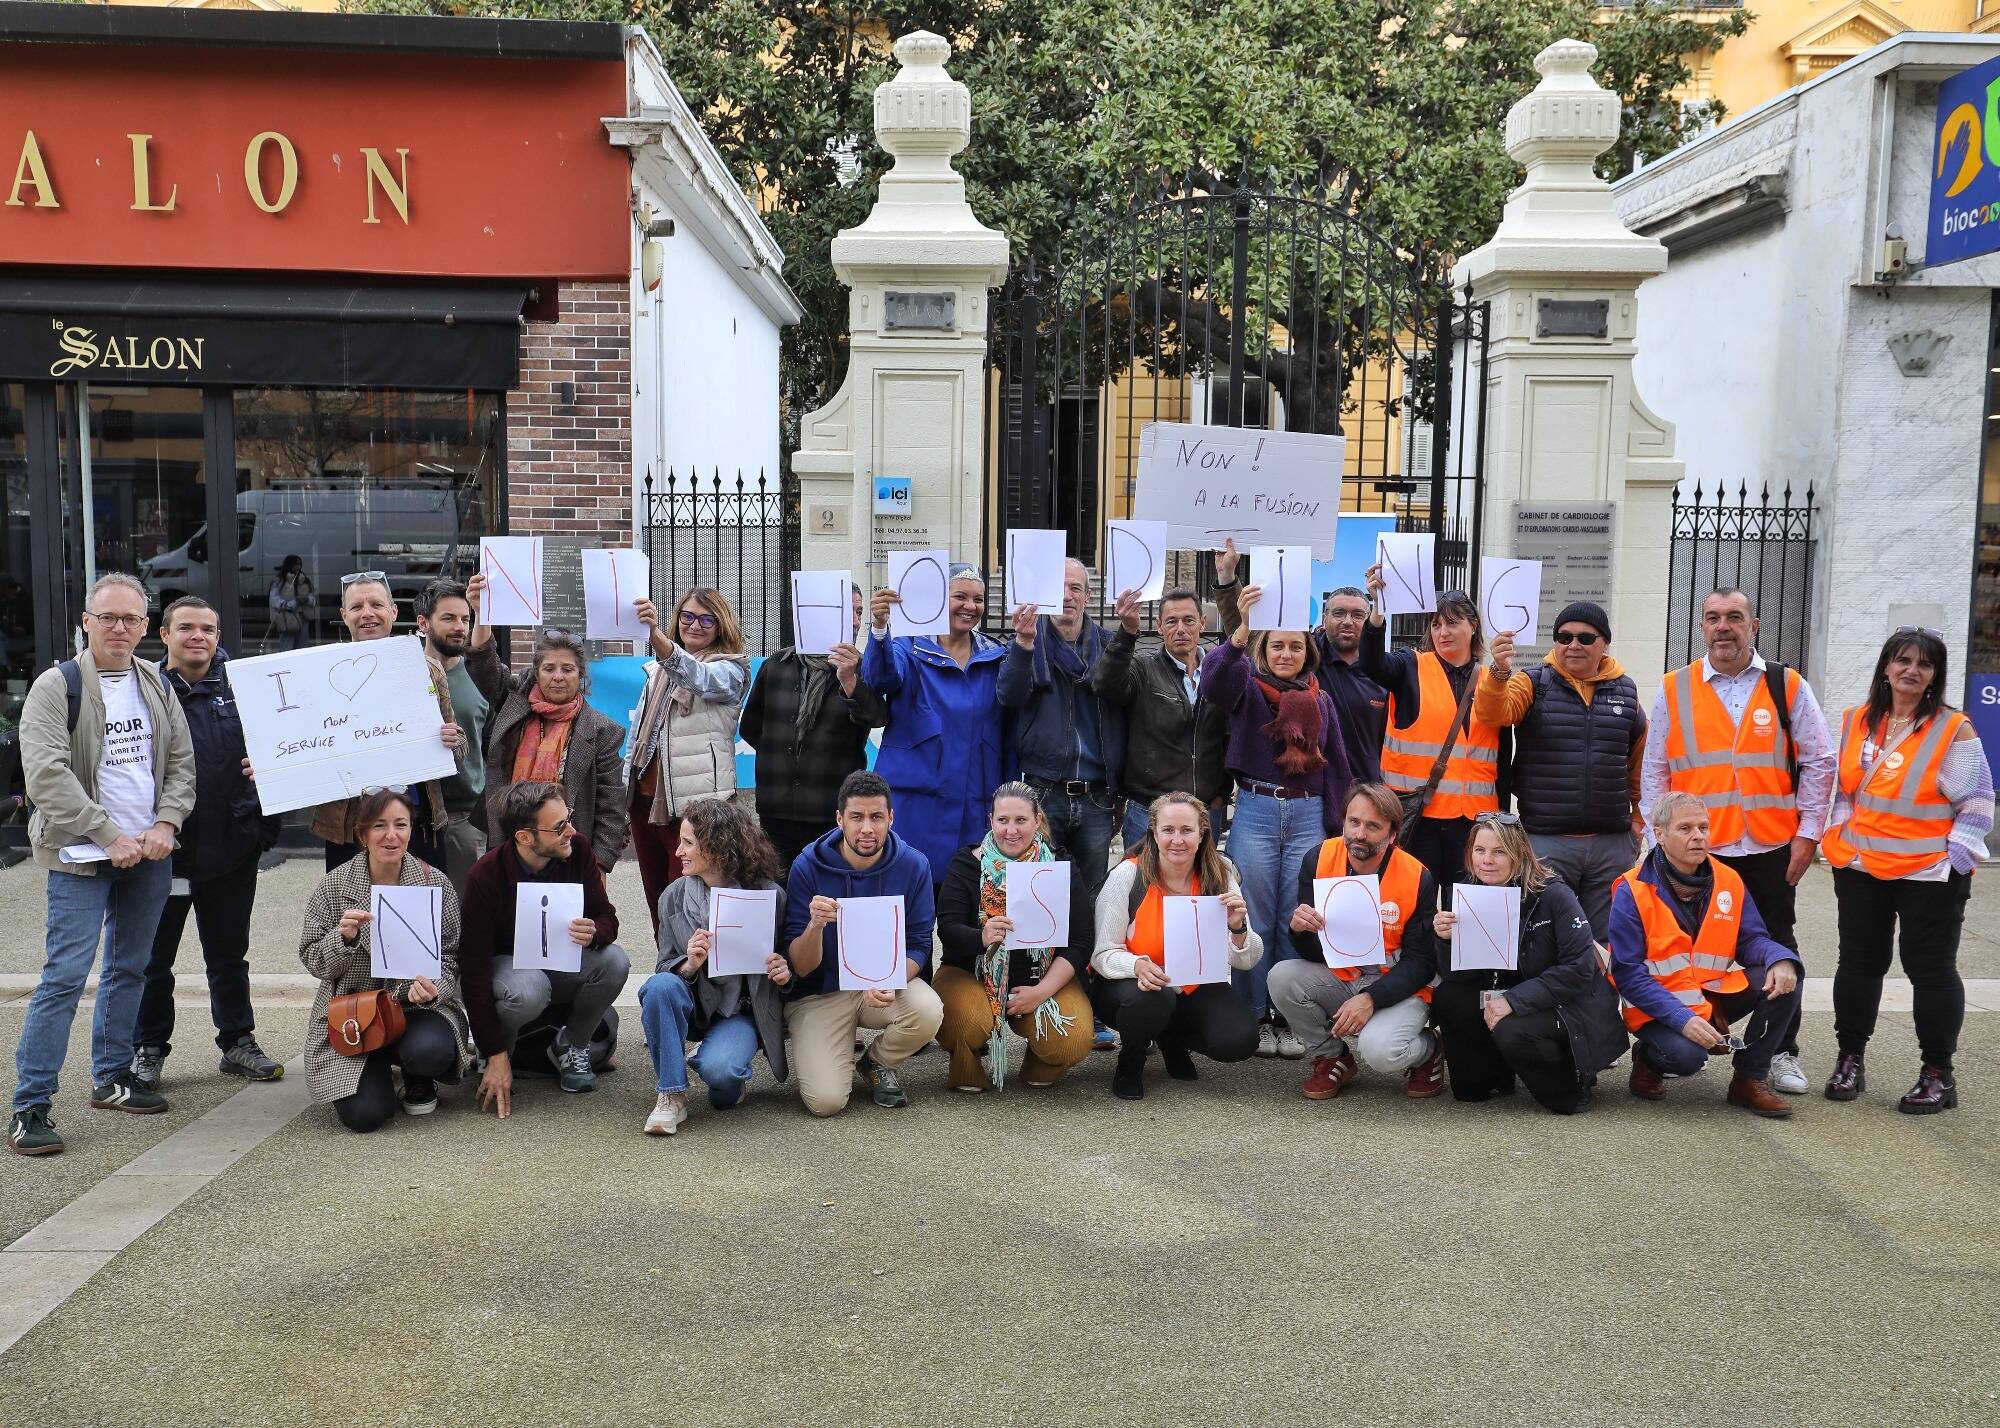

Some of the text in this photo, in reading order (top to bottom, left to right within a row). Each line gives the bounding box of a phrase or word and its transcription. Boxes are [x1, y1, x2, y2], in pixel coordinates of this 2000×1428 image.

[50, 326, 205, 377] SALON
[52, 318, 64, 330] le
[1176, 439, 1236, 470] NON
[822, 510, 835, 529] 2
[891, 487, 908, 500] ici
[1194, 488, 1207, 507] A
[1221, 493, 1239, 509] LA
[1518, 511, 1611, 521] CABINET DE CARDIOLOGIE
[484, 538, 540, 622] N
[1011, 534, 1057, 607] L
[1111, 526, 1153, 600] D
[1380, 539, 1425, 613] N
[795, 579, 845, 650] H
[1487, 566, 1531, 634] G
[106, 717, 144, 736] POUR
[266, 670, 300, 713] I
[377, 889, 440, 970] N
[715, 894, 768, 971] F
[1015, 868, 1057, 944] S
[1323, 879, 1382, 958] O
[1457, 889, 1511, 968] N
[840, 904, 900, 983] U
